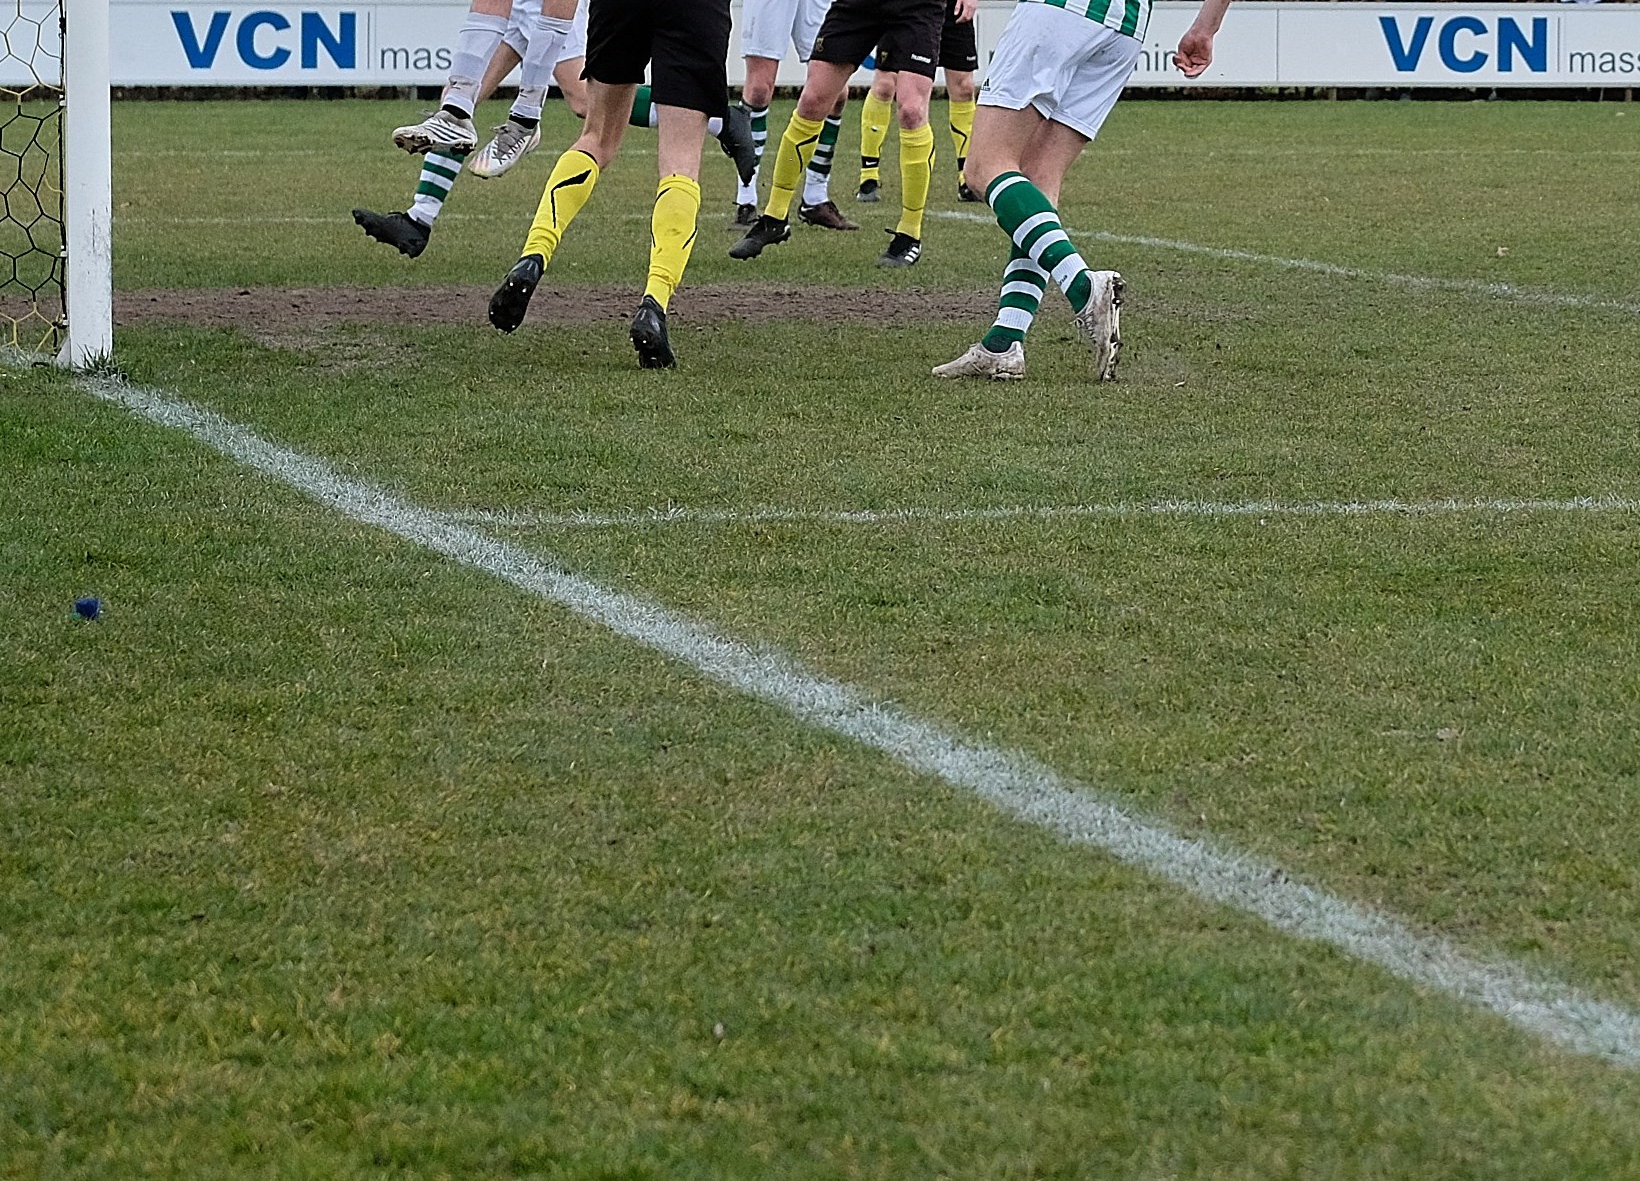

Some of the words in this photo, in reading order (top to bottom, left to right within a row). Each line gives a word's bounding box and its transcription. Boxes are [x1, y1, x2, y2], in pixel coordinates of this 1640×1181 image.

[170, 10, 356, 69] VCN
[380, 47, 452, 69] mas
[1378, 16, 1547, 73] VCN
